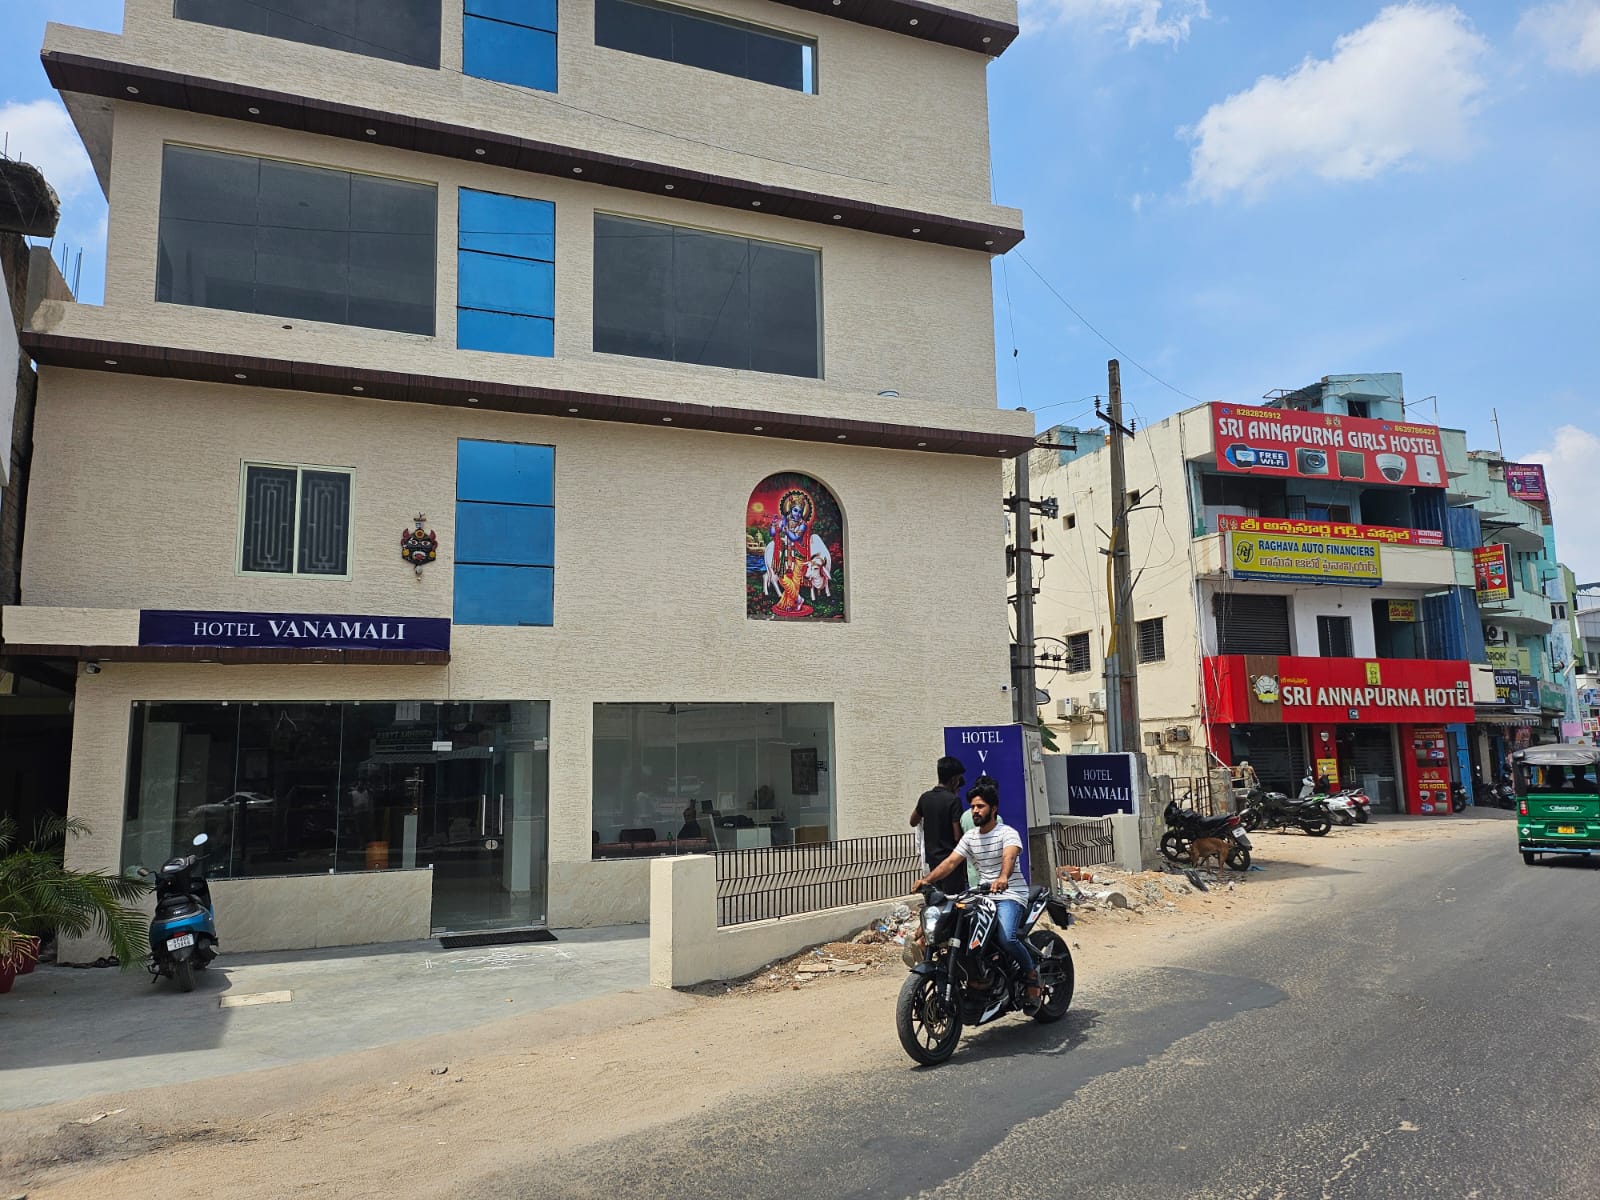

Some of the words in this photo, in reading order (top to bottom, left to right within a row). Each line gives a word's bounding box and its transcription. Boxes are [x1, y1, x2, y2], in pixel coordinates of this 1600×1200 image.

[1218, 417, 1244, 439] SRI
[1248, 421, 1344, 448] ANNAPURNA
[1348, 431, 1387, 451] GIRLS
[1390, 435, 1440, 456] HOSTEL
[1259, 451, 1284, 460] FREE
[1260, 458, 1285, 466] WI-FI
[1258, 540, 1299, 553] RAGHAVA
[1301, 542, 1324, 554] AUTO
[1326, 544, 1375, 557] FINANCIERS
[193, 621, 261, 638] HOTEL
[267, 619, 407, 641] VANAMALI
[1495, 675, 1518, 686] SILVER
[1282, 686, 1312, 706] SRI
[1316, 687, 1421, 707] ANNAPURNA
[1424, 687, 1474, 707] HOTEL
[961, 731, 1004, 744] HOTEL
[1083, 768, 1113, 782] HOTEL
[1070, 785, 1129, 801] VANAMALI
